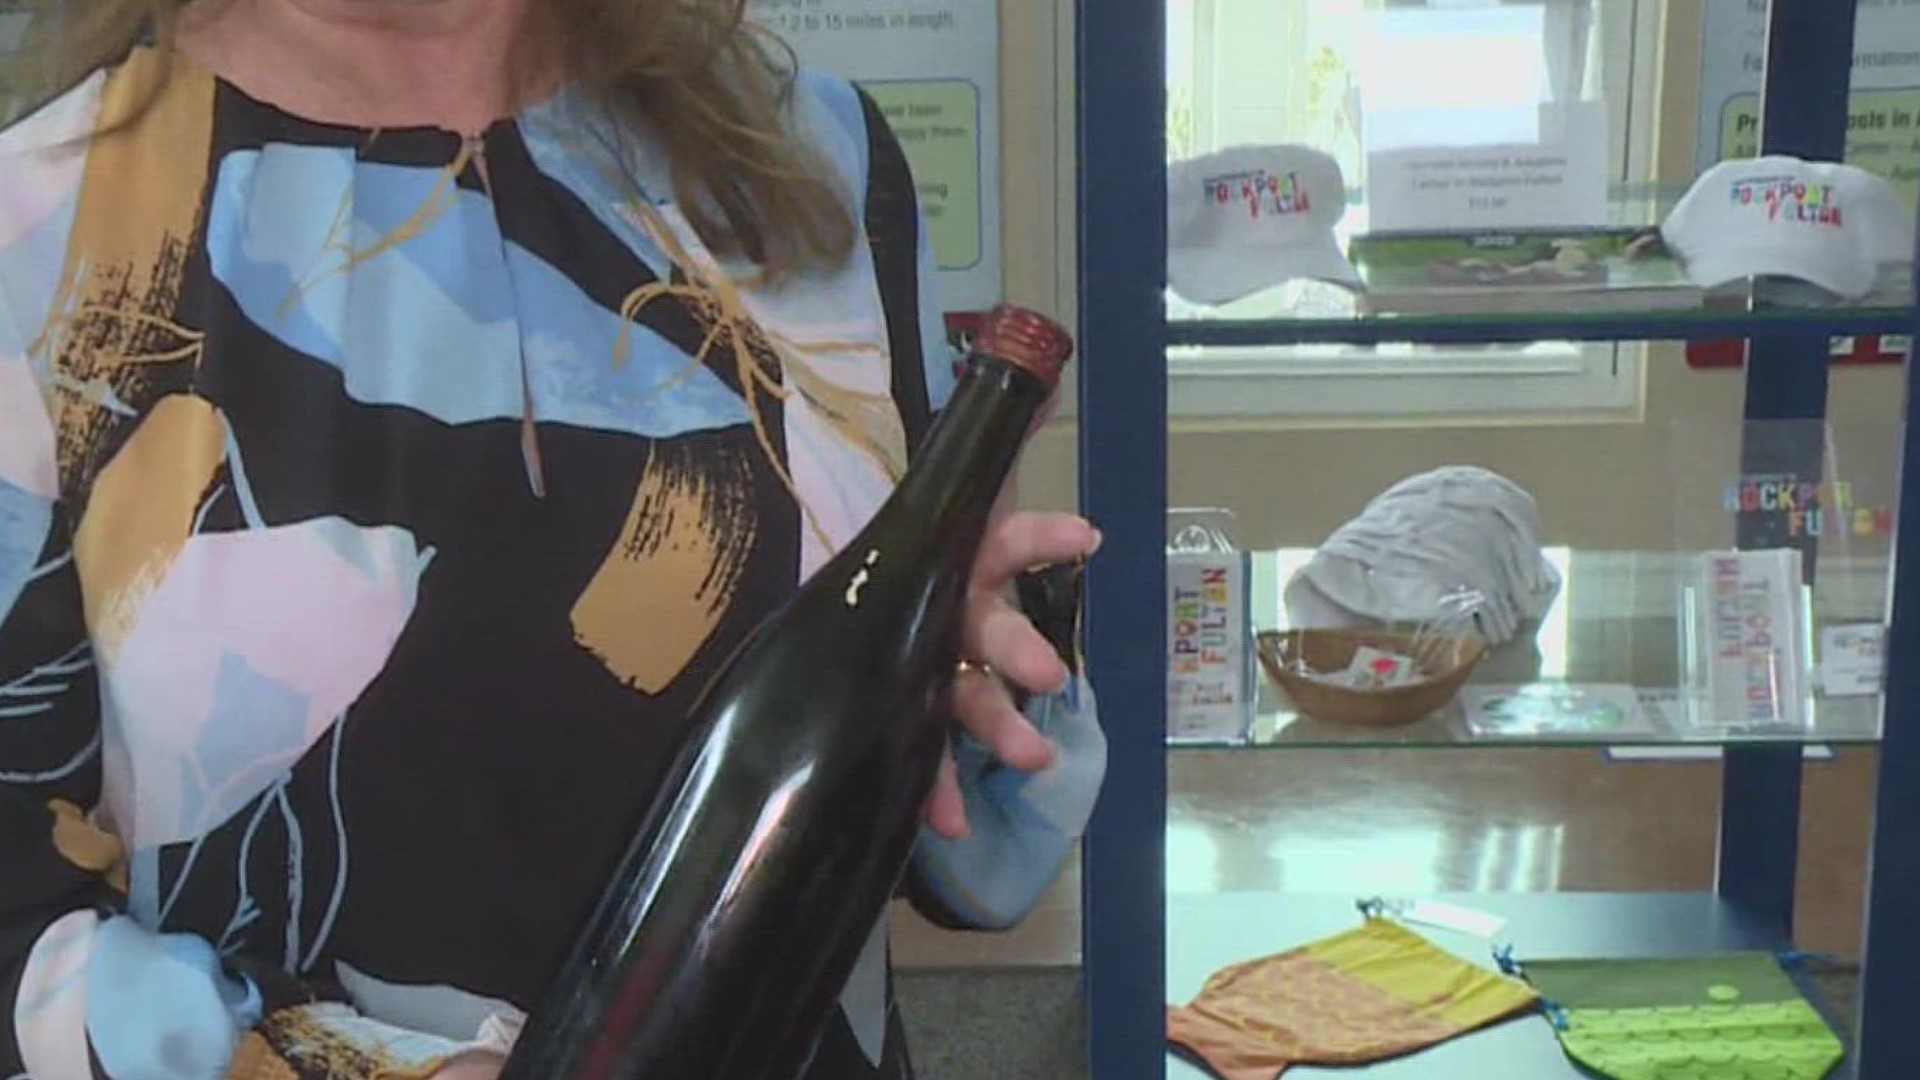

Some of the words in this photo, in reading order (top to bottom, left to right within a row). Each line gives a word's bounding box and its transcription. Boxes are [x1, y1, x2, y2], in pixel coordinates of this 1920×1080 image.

[1738, 113, 1758, 132] Pr
[1892, 108, 1911, 127] in
[1200, 568, 1227, 665] FULTON
